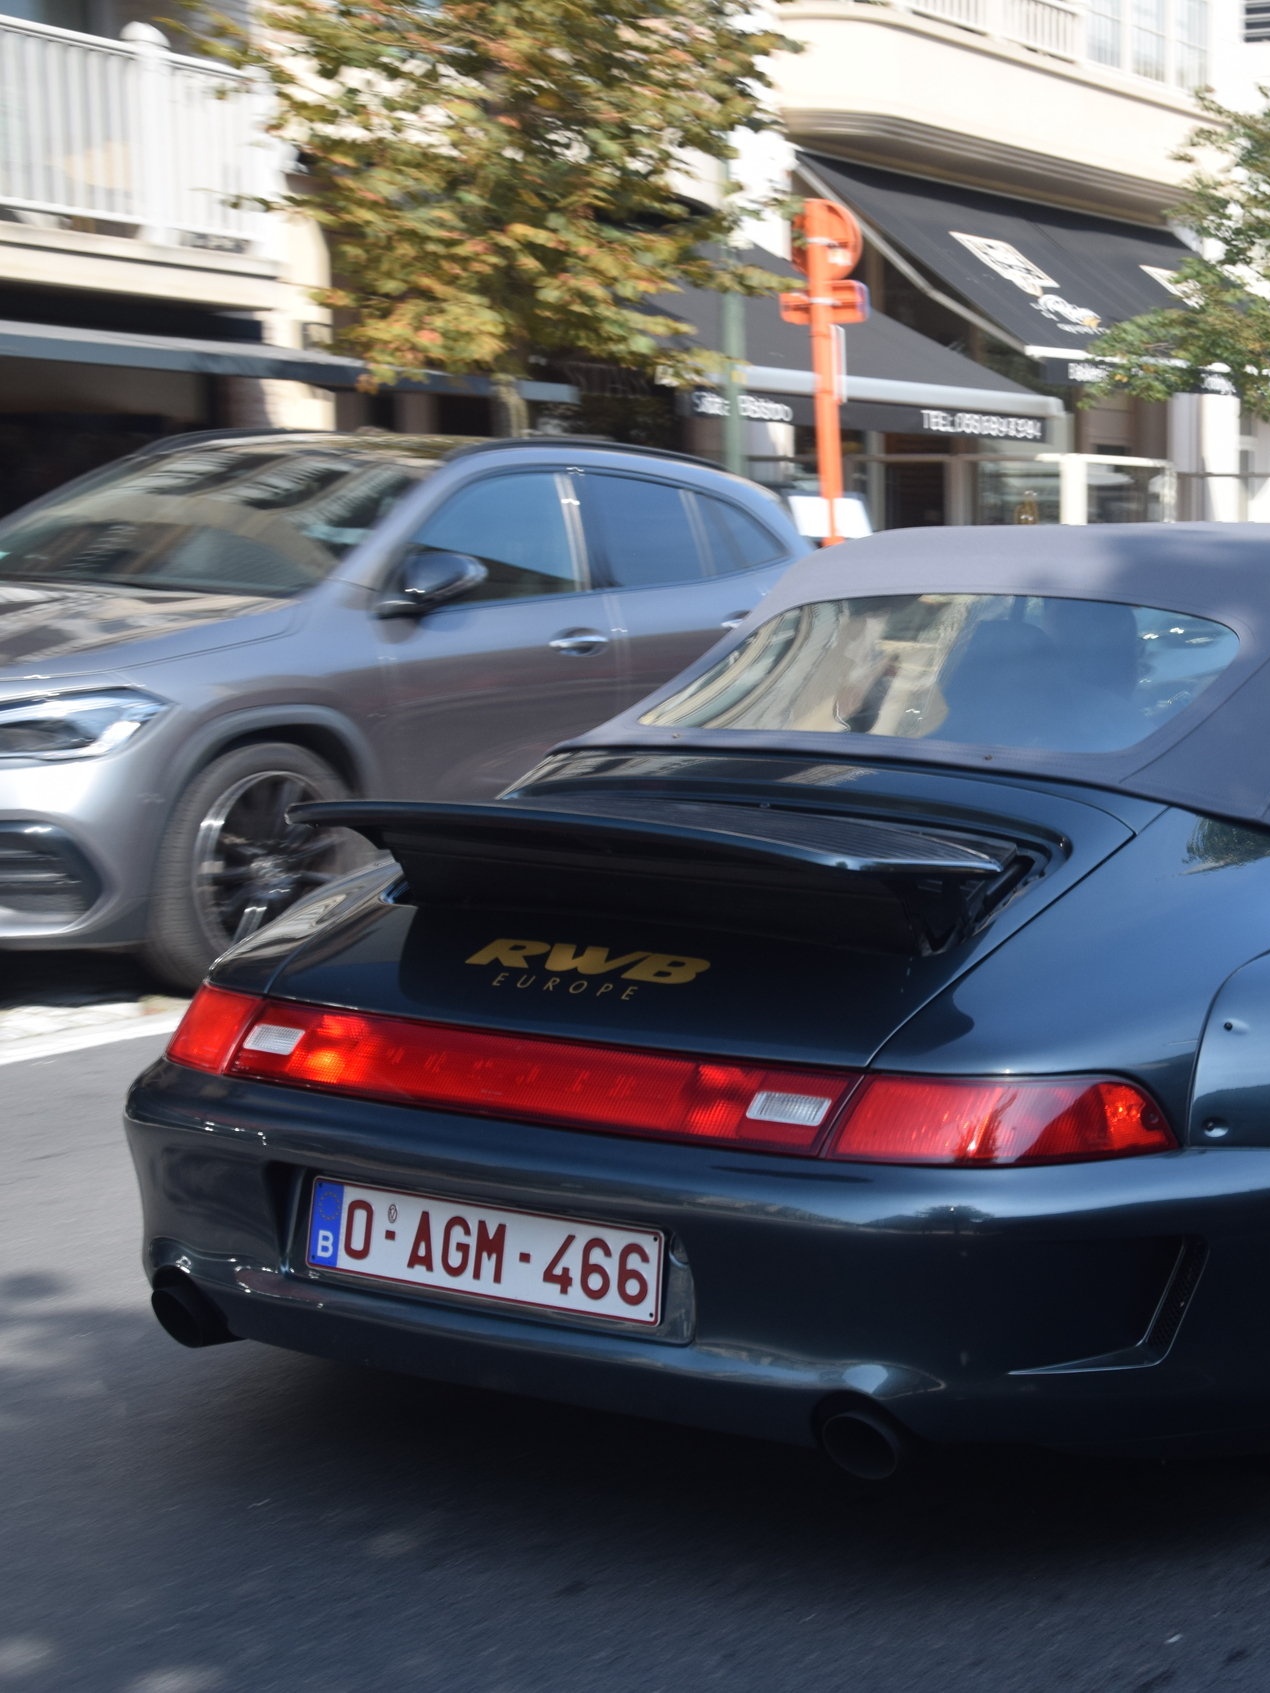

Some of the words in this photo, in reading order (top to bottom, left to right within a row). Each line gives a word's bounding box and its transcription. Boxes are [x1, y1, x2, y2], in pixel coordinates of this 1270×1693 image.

[465, 938, 711, 985] RWB
[492, 972, 638, 1001] EUROPE
[316, 1230, 334, 1258] B
